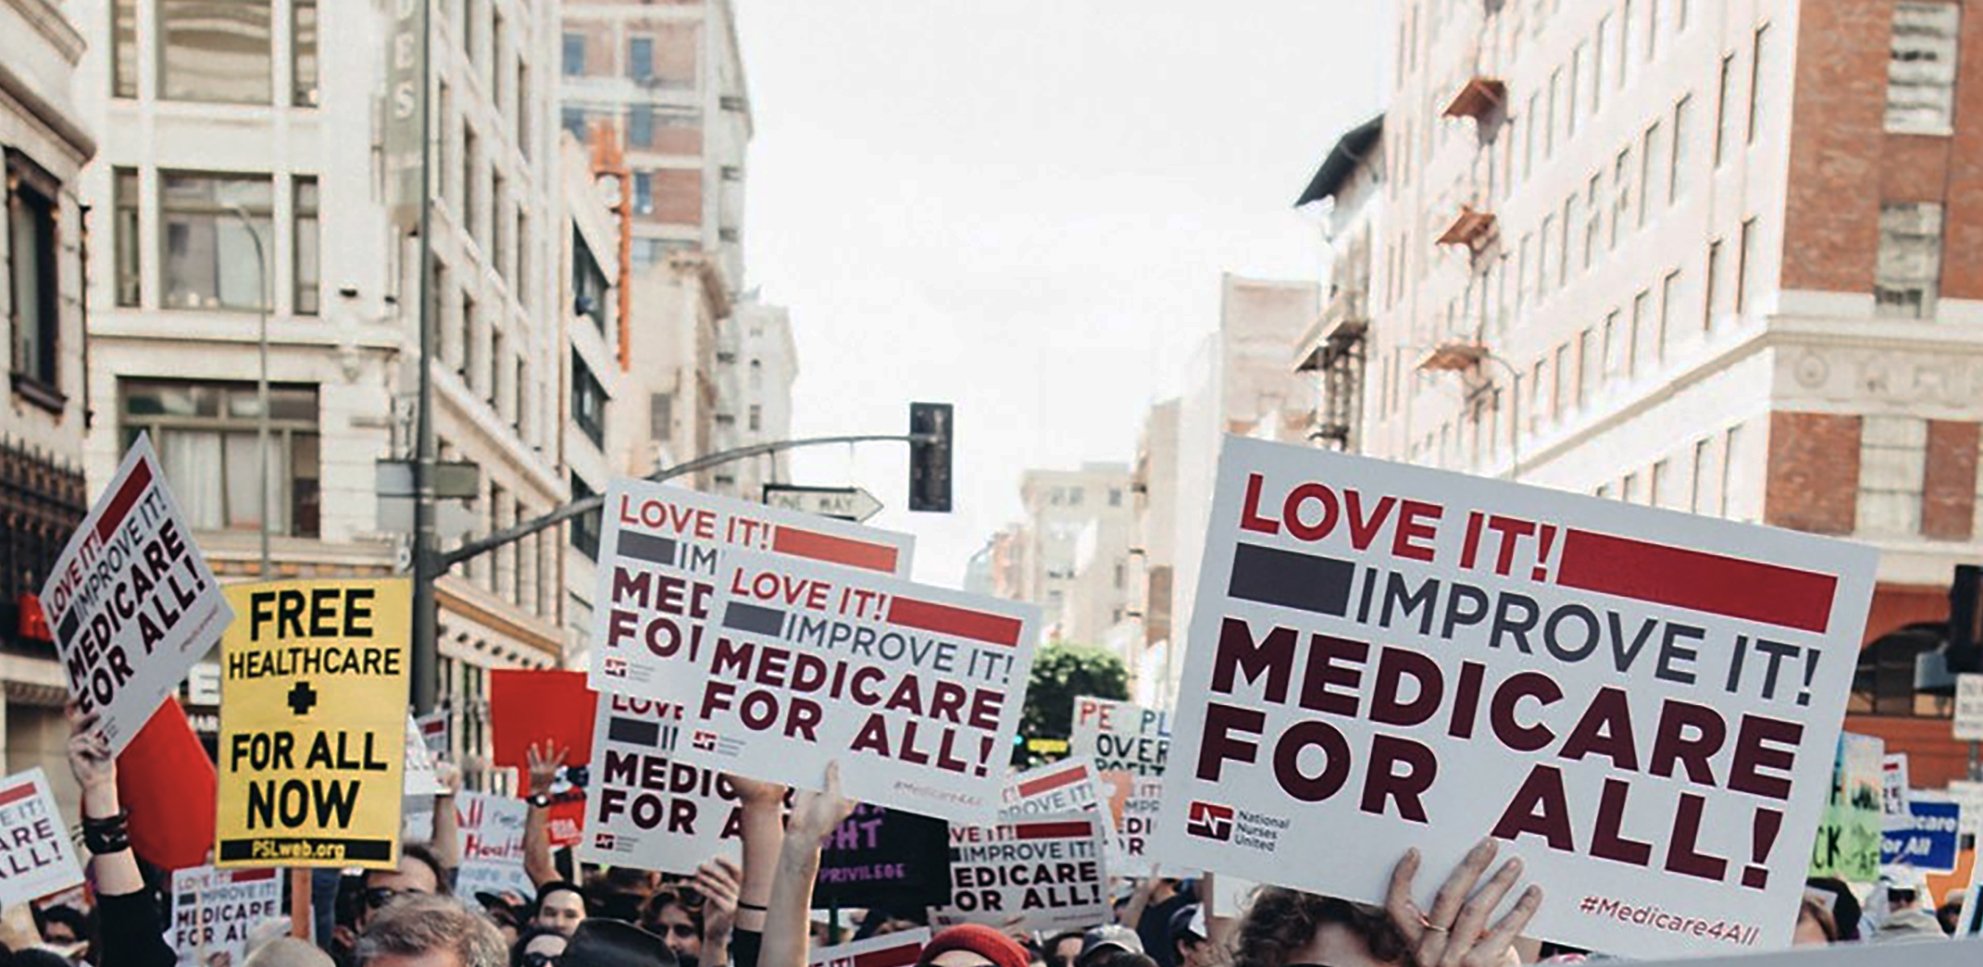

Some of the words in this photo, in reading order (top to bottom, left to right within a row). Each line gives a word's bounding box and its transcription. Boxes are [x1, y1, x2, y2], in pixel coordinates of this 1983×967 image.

[619, 494, 717, 539] LOVE
[726, 515, 770, 550] IT!
[1240, 473, 1444, 562] LOVE
[1459, 510, 1557, 582] IT!
[47, 558, 83, 625] LOVE
[79, 528, 103, 570] IT!
[72, 516, 144, 622] IMPROVE
[138, 485, 168, 530] IT!
[67, 517, 186, 691] MEDICARE
[250, 588, 376, 642] FREE
[730, 567, 831, 611] LOVE
[838, 587, 888, 621] IT!
[78, 645, 135, 715] FOR
[136, 554, 206, 656] ALL!
[786, 613, 957, 672] IMPROVE
[967, 648, 1015, 684] IT!
[1356, 566, 1705, 685] IMPROVE
[1725, 634, 1822, 707] IT!
[228, 646, 402, 680] HEALTHCARE
[710, 637, 1006, 731] MEDICARE
[699, 679, 823, 743] FOR
[850, 713, 995, 777] ALL!
[1210, 616, 1804, 801] MEDICARE
[231, 730, 295, 773] FOR
[305, 730, 388, 771] ALL
[603, 749, 740, 801] MEDIC
[1096, 733, 1170, 764] OVER
[247, 778, 361, 830] NOW
[598, 788, 698, 835] FOR
[1196, 701, 1439, 825] FOR
[1490, 763, 1783, 891] ALL!
[1237, 810, 1290, 829] National
[251, 840, 346, 859] PSLweb.org
[963, 842, 1063, 863] IMPROVE
[1069, 841, 1095, 858] IT!
[1233, 834, 1276, 853] United
[1236, 822, 1278, 840] Nurses
[952, 861, 1099, 888] EDICARE
[953, 889, 1003, 912] OR
[1021, 884, 1100, 910] ALL!
[1580, 896, 1759, 947] #Medicare4All
